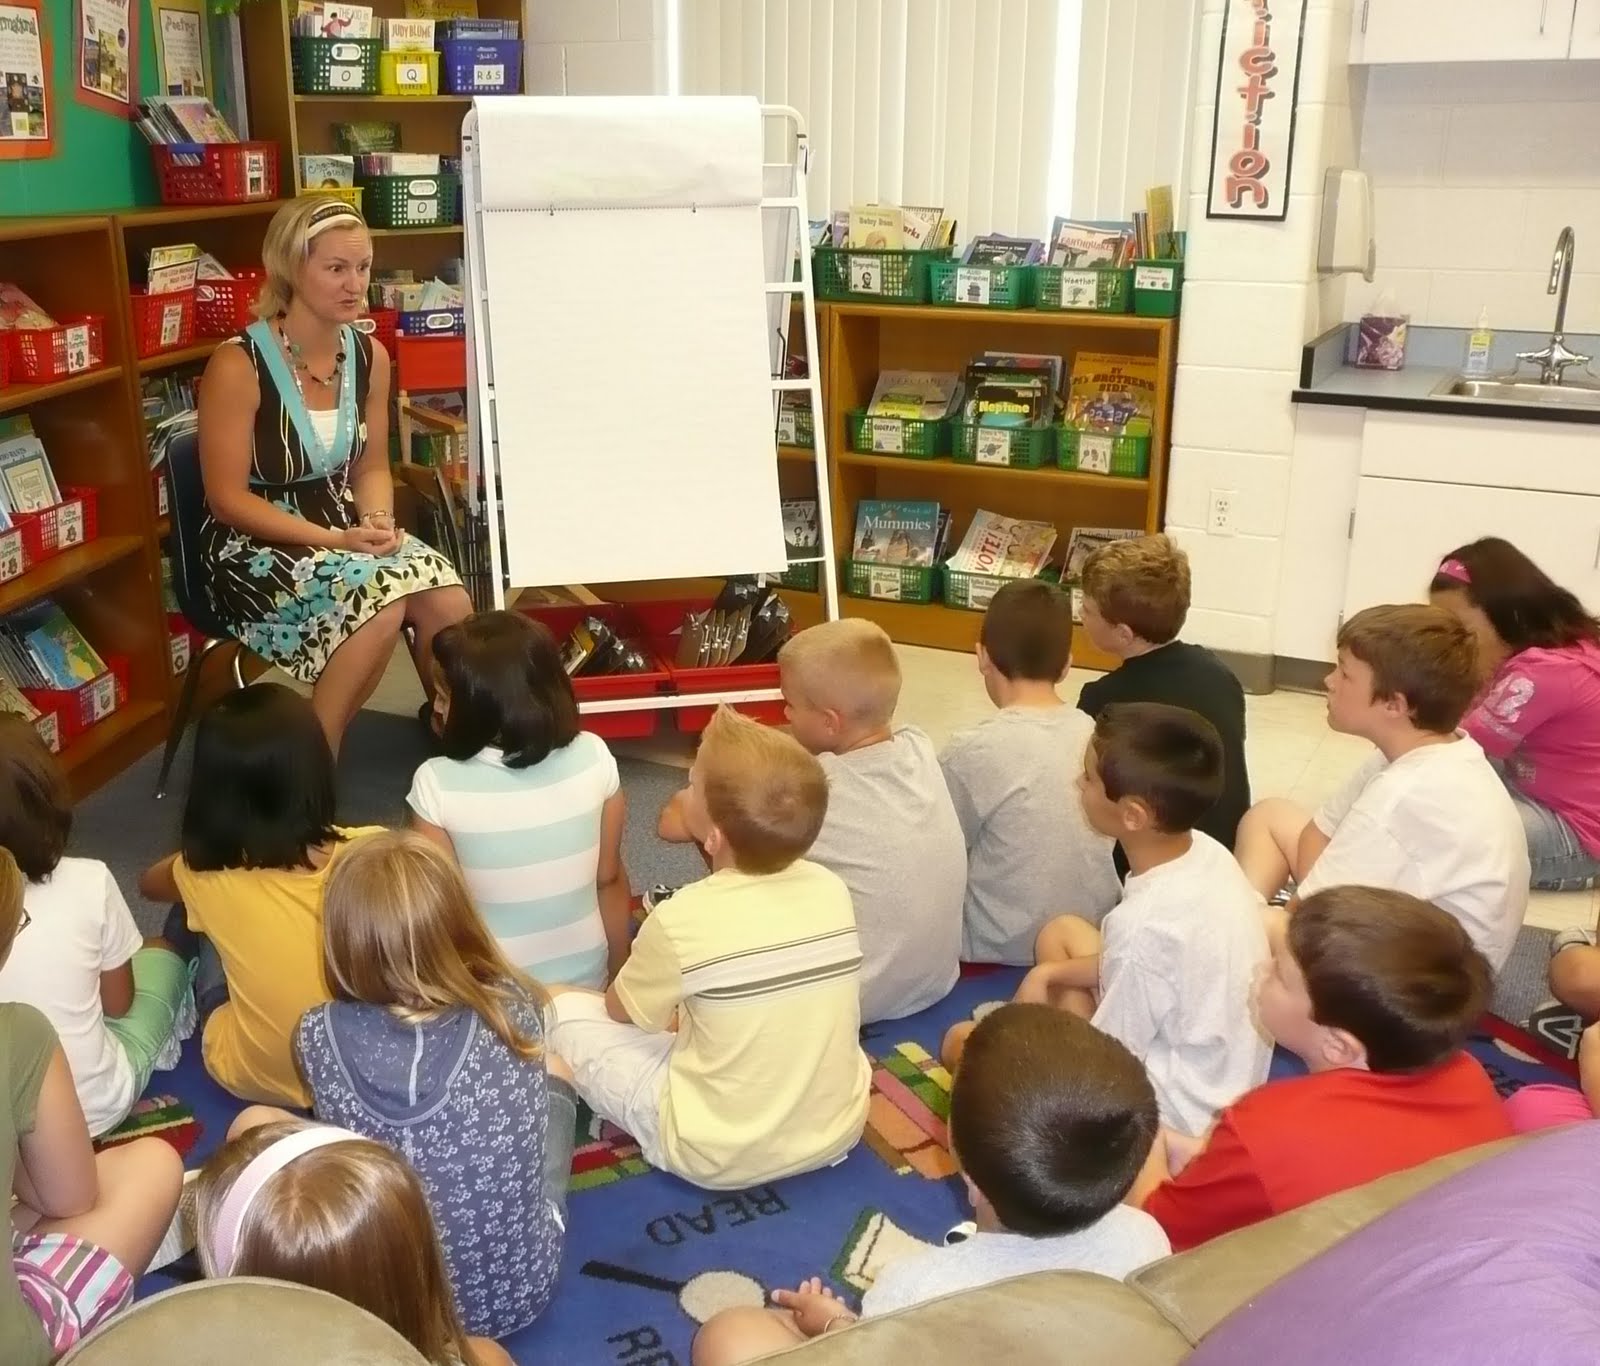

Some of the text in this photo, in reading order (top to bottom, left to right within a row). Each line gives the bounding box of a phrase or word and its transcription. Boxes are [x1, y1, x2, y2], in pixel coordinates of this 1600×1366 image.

[392, 23, 432, 38] JUDY BLUME
[341, 70, 351, 82] O
[406, 69, 417, 83] Q
[477, 71, 502, 80] R & S
[1225, 0, 1278, 209] iction
[417, 202, 427, 213] O
[1060, 237, 1116, 252] EARTHQUAKES
[1064, 277, 1096, 286] Weather
[1111, 366, 1123, 374] BY
[1092, 374, 1155, 391] BROTHER'S
[1098, 383, 1128, 393] SIDE
[979, 400, 1030, 415] Neptune
[863, 515, 931, 530] Mummies
[974, 532, 1003, 573] VOTE!
[645, 1185, 791, 1247] READ
